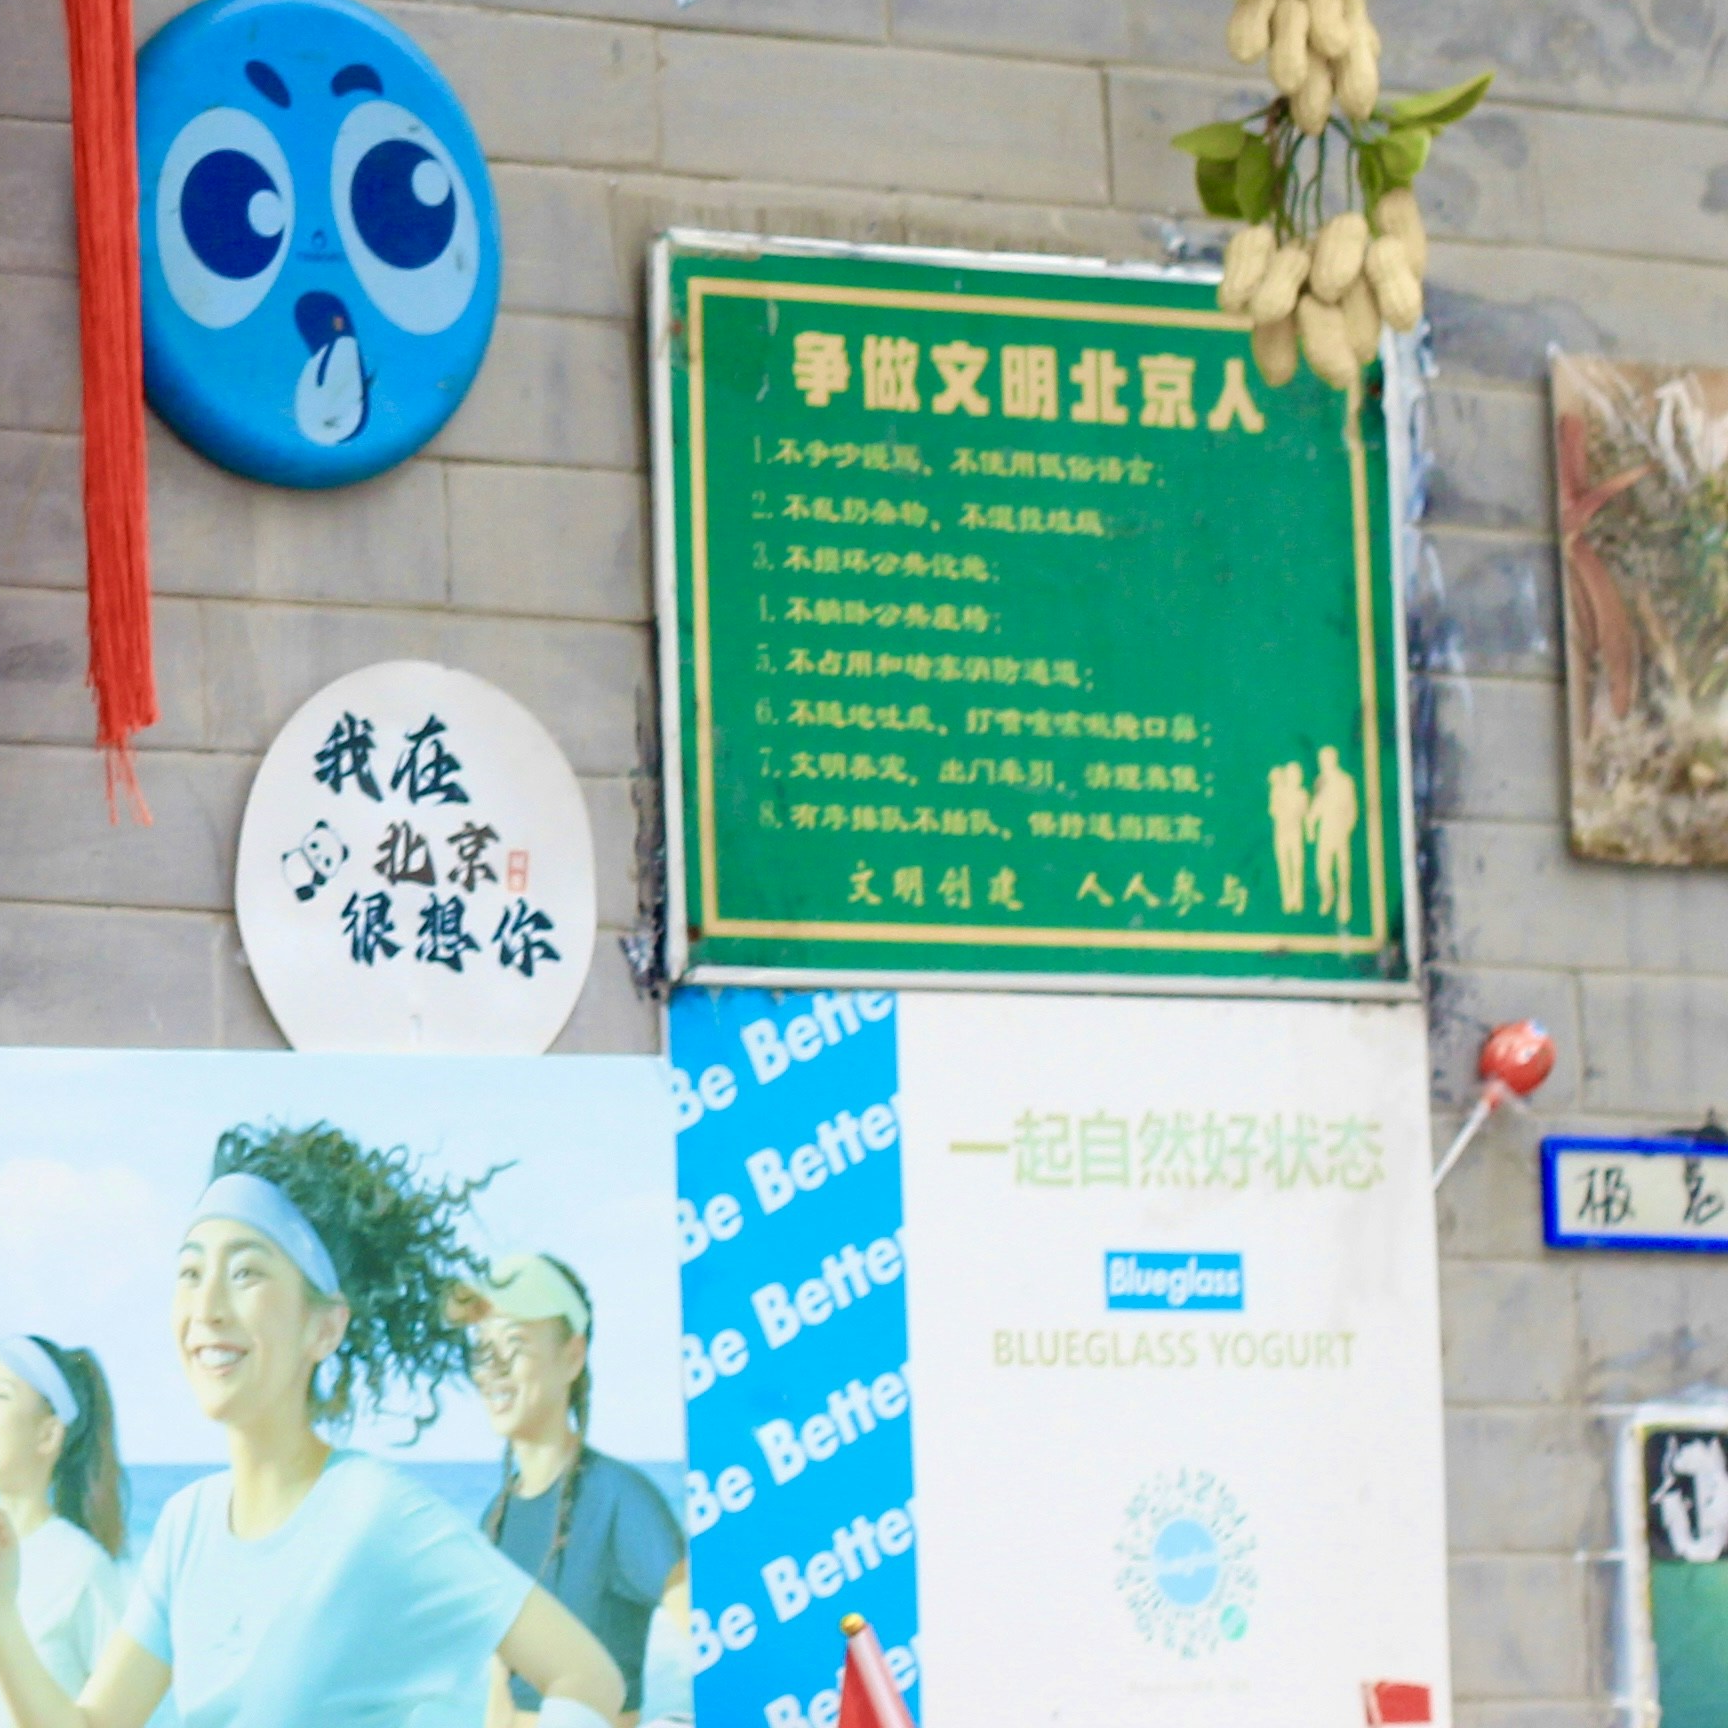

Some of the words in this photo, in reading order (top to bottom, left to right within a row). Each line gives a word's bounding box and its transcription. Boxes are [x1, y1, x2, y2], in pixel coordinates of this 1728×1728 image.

[792, 330, 1265, 434] 争做文明北京人
[314, 710, 470, 805] 我在
[373, 819, 501, 893] 北京
[848, 859, 1024, 912] 文明创建
[1076, 866, 1250, 917] 人人参与
[340, 890, 561, 979] 很想你
[948, 1109, 1387, 1191] 一起自然好状态
[1108, 1256, 1240, 1308] Blueglass
[993, 1329, 1198, 1369] BLUEGLASS
[1210, 1330, 1358, 1369] YOGURT
